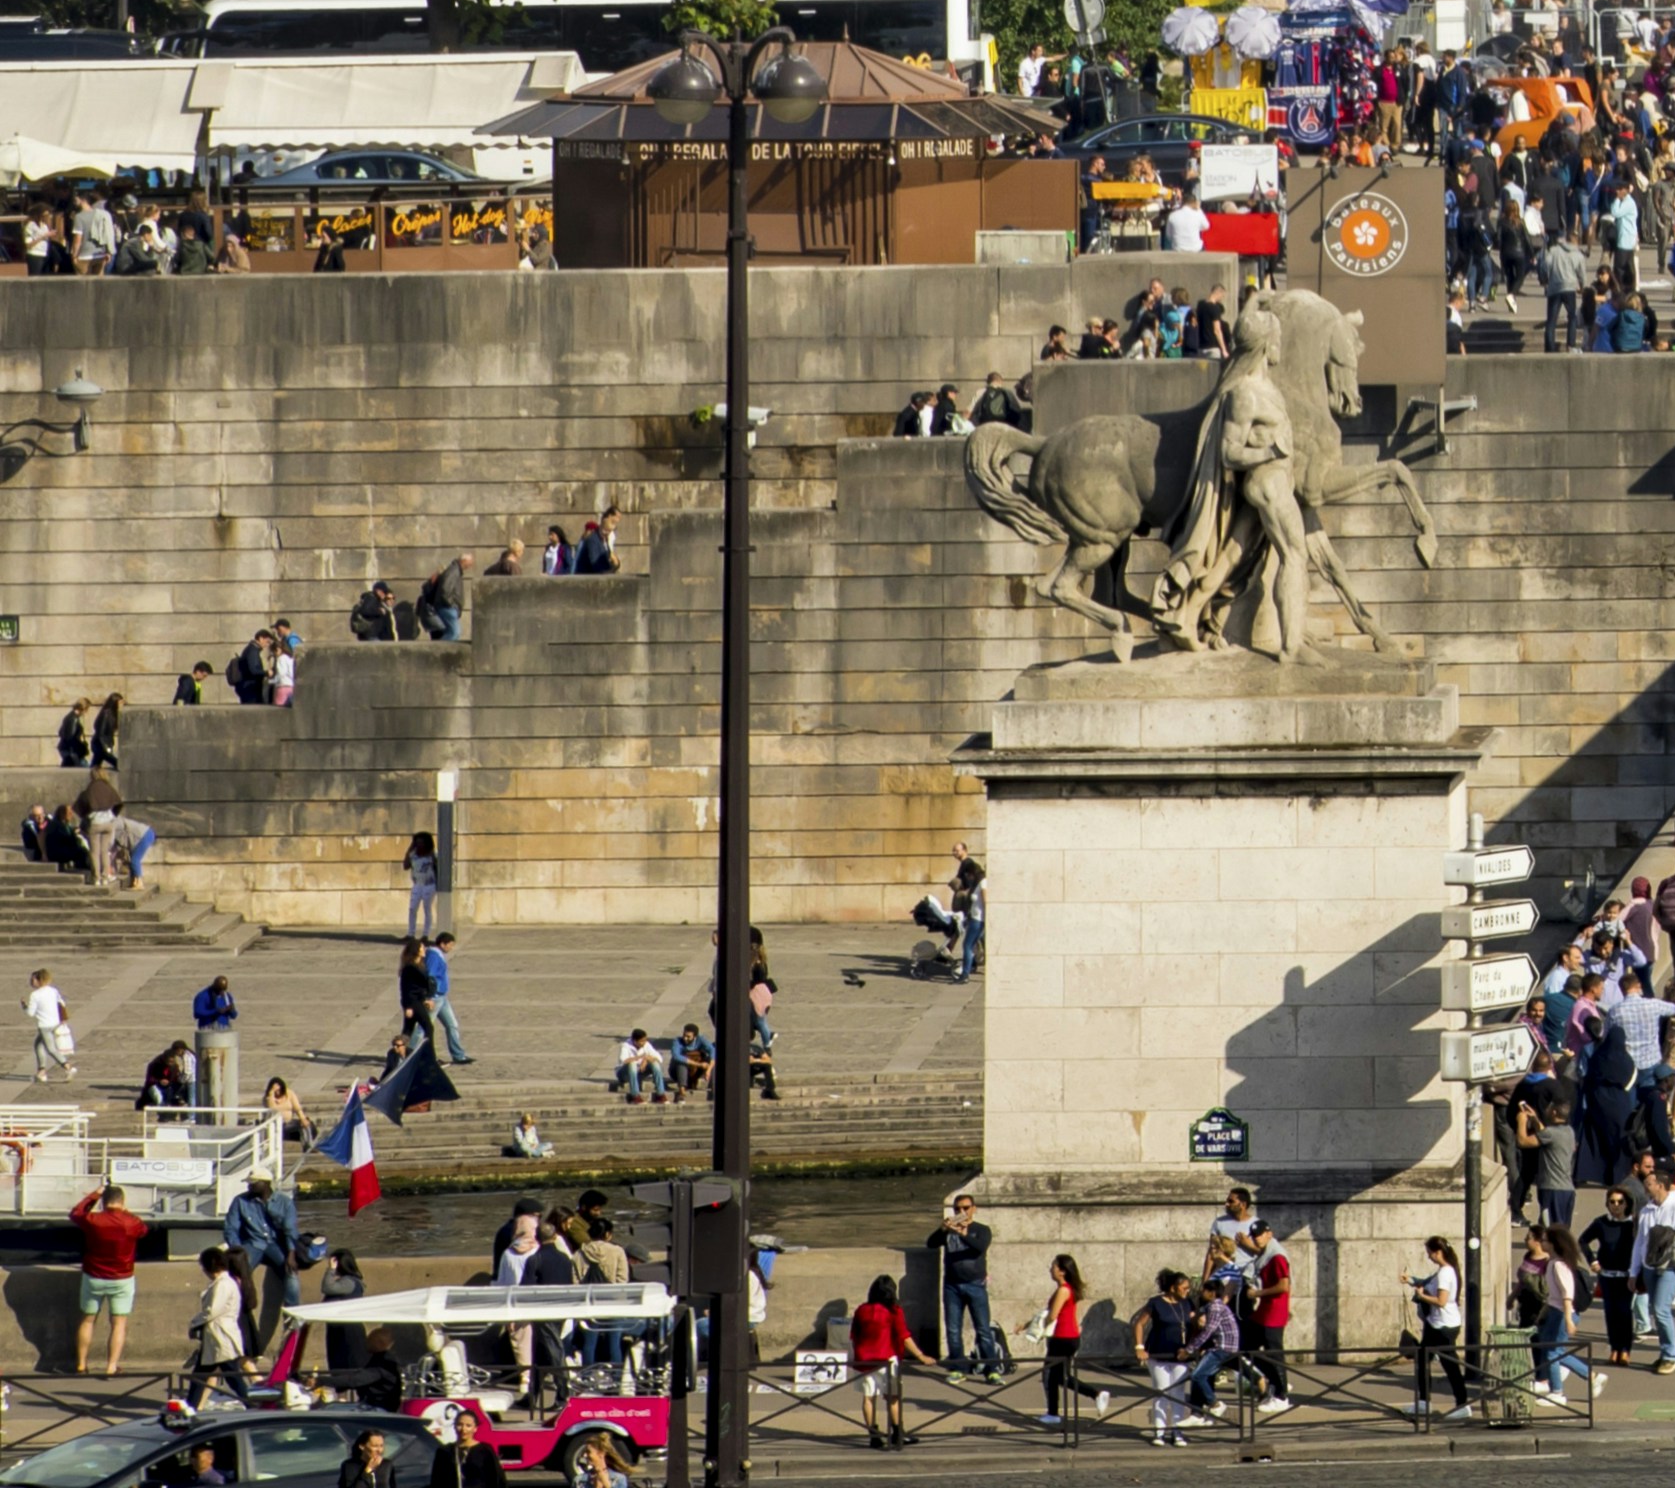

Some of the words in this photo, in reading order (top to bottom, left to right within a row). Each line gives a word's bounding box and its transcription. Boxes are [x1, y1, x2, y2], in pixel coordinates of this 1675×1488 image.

[672, 143, 728, 159] REGALA
[752, 142, 771, 160] DE
[774, 142, 792, 159] LA
[901, 143, 916, 159] OH
[1331, 197, 1400, 230] bateaux
[393, 210, 441, 236] Crêpes
[1331, 238, 1402, 274] Parisiens
[1476, 858, 1511, 875] INVALIDES
[1473, 911, 1520, 929] CAMBRONNE
[1474, 972, 1490, 983] Parc
[1493, 971, 1502, 981] du
[1474, 988, 1498, 1002] Champ
[1500, 987, 1508, 997] de
[1509, 984, 1526, 996] Mars
[1208, 1132, 1231, 1141] PLACE
[1196, 1144, 1206, 1153] DE
[1207, 1144, 1243, 1153] VARSOVIE
[116, 1162, 207, 1171] BATOBUS
